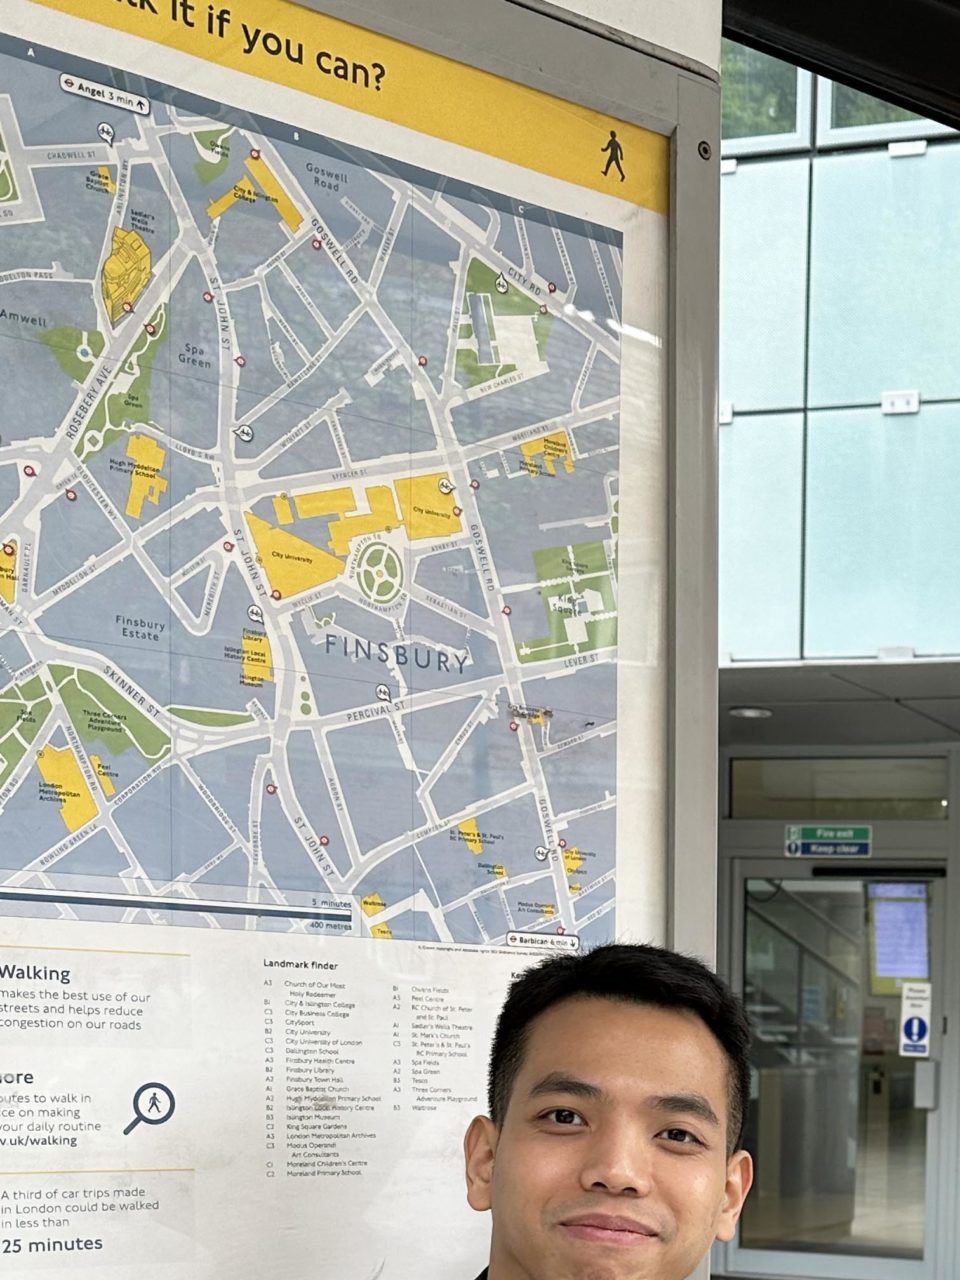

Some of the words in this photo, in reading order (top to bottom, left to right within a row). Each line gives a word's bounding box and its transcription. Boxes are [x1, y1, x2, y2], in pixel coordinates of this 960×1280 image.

[27, 47, 36, 57] A
[207, 4, 231, 38] if
[241, 23, 303, 65] you
[316, 51, 386, 91] can?
[77, 82, 105, 98] Angel
[108, 92, 114, 100] 3
[116, 95, 133, 106] min
[293, 131, 300, 141] B
[306, 162, 349, 184] Goswell
[314, 177, 340, 192] Road
[518, 205, 524, 214] C
[311, 218, 345, 268] GOSWELL
[346, 269, 359, 285] RD
[508, 267, 527, 285] CITY
[529, 283, 541, 296] RD
[217, 299, 229, 333] JOHN
[185, 343, 204, 356] Spa
[178, 353, 211, 369] Green
[66, 387, 99, 440] ROSEBERY
[98, 366, 112, 388] AVE
[234, 529, 245, 542] ST
[241, 549, 259, 581] JOHN
[256, 584, 267, 598] ST
[272, 550, 284, 560] City
[285, 552, 313, 564] University
[471, 523, 488, 574] GOSWELL
[485, 578, 494, 592] RD
[115, 615, 165, 632] Finsbury
[122, 627, 159, 642] Estate
[325, 634, 468, 675] FINSBURY
[564, 657, 588, 668] LEVER
[590, 654, 599, 663] ST
[103, 665, 145, 706] SKINNER
[146, 705, 161, 718] ST
[347, 702, 391, 722] PERCIVAL
[394, 700, 405, 711] ST
[38, 781, 63, 790] London
[540, 798, 555, 846] GOSWELL
[816, 829, 835, 838] Fire
[836, 829, 854, 838] exit
[294, 815, 305, 829] ST
[304, 834, 324, 864] JOHN
[323, 864, 335, 877] ST
[312, 898, 317, 906] 5
[321, 898, 352, 908] minutes
[326, 923, 352, 932] metres
[520, 937, 549, 945] Barbican
[263, 958, 309, 969] Landmark
[311, 961, 338, 970] finder
[0, 965, 70, 984] Walking
[39, 990, 59, 1000] the
[63, 990, 88, 1001] best
[92, 993, 112, 1001] use
[115, 991, 127, 1002] of
[131, 994, 151, 1003] our
[43, 1004, 65, 1014] and
[69, 1005, 100, 1016] helps
[104, 1006, 143, 1016] reduce
[67, 1020, 82, 1029] on
[86, 1020, 105, 1029] our
[109, 1020, 142, 1030] roads
[34, 1094, 47, 1103] to
[50, 1093, 78, 1104] walk
[81, 1094, 91, 1103] in
[19, 1109, 34, 1117] on
[38, 1107, 80, 1120] making
[27, 1121, 55, 1133] daily
[59, 1122, 101, 1132] routine
[1, 1191, 10, 1200] A
[13, 1190, 42, 1200] third
[45, 1189, 59, 1200] of
[61, 1190, 79, 1199] car
[83, 1188, 110, 1200] trips
[113, 1187, 146, 1197] made
[1, 1205, 12, 1214] in
[16, 1203, 62, 1214] London
[65, 1202, 98, 1213] could
[102, 1202, 116, 1212] be
[119, 1200, 160, 1211] walked
[1, 1219, 12, 1229] in
[16, 1219, 39, 1229] less
[43, 1218, 70, 1228] than
[2, 1239, 22, 1254] 25
[28, 1238, 103, 1253] minutes
